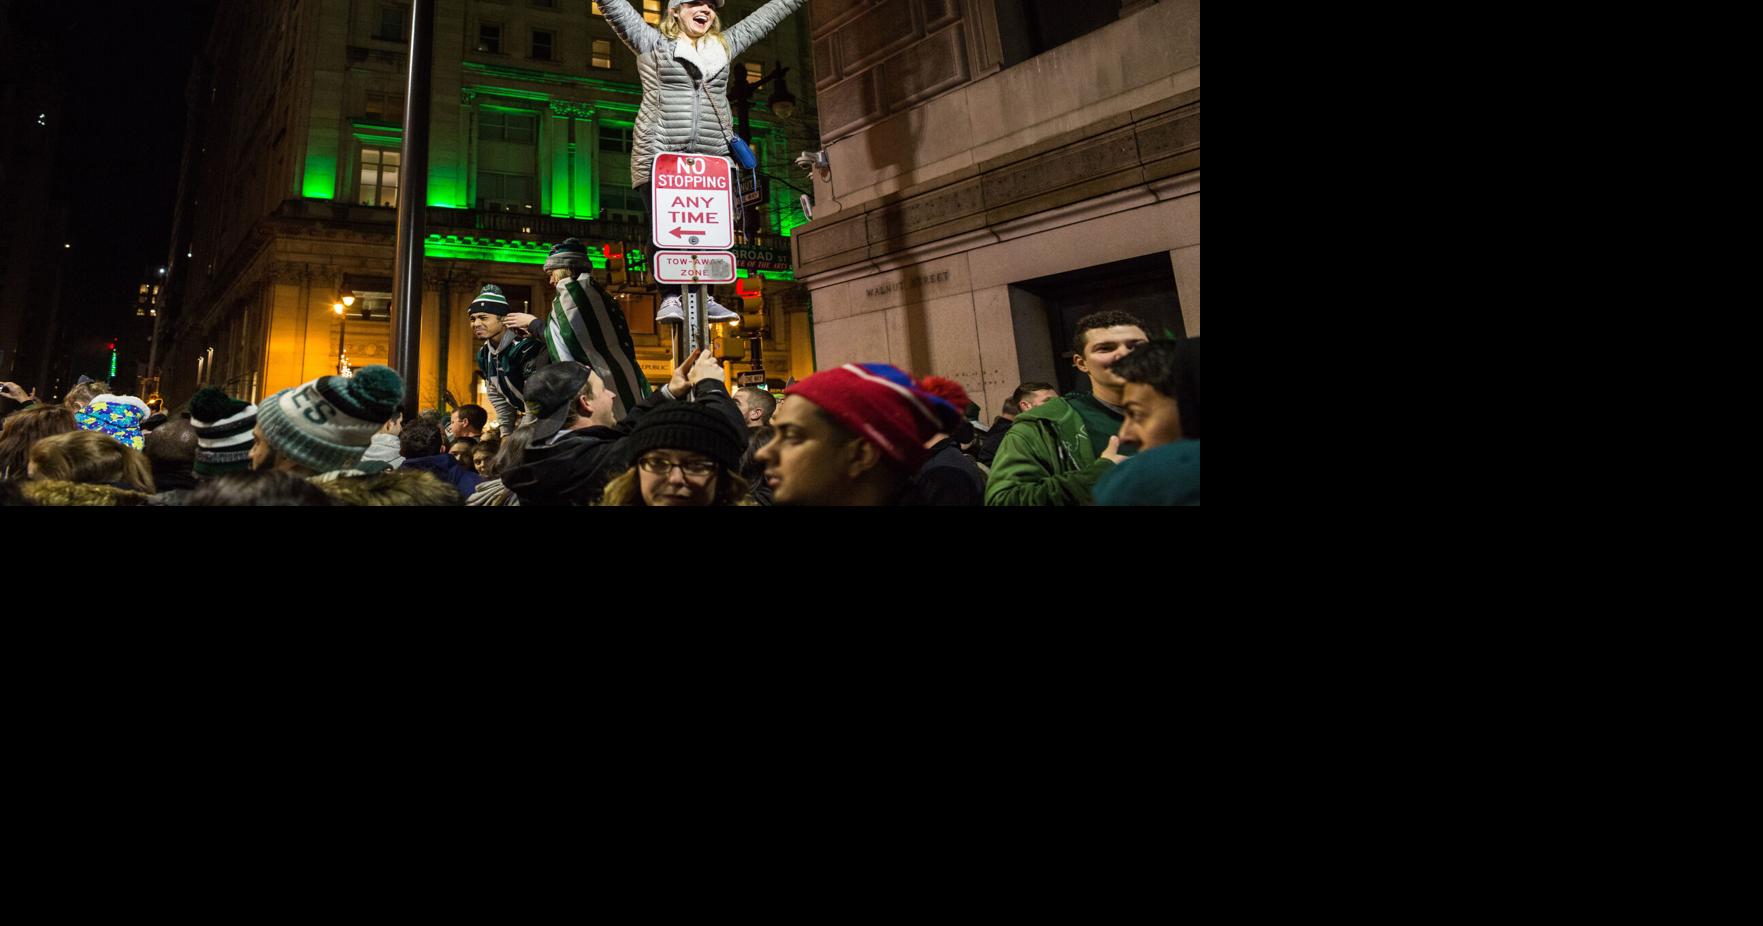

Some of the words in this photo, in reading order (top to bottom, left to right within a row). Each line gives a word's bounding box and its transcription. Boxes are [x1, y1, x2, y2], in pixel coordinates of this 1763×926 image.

[677, 157, 706, 175] NO
[658, 174, 727, 189] STOPPING
[671, 196, 714, 209] ANY
[668, 211, 719, 224] TIME
[732, 249, 773, 261] BROAD
[667, 258, 724, 266] TOW-AWAY
[865, 280, 904, 297] WALNUT
